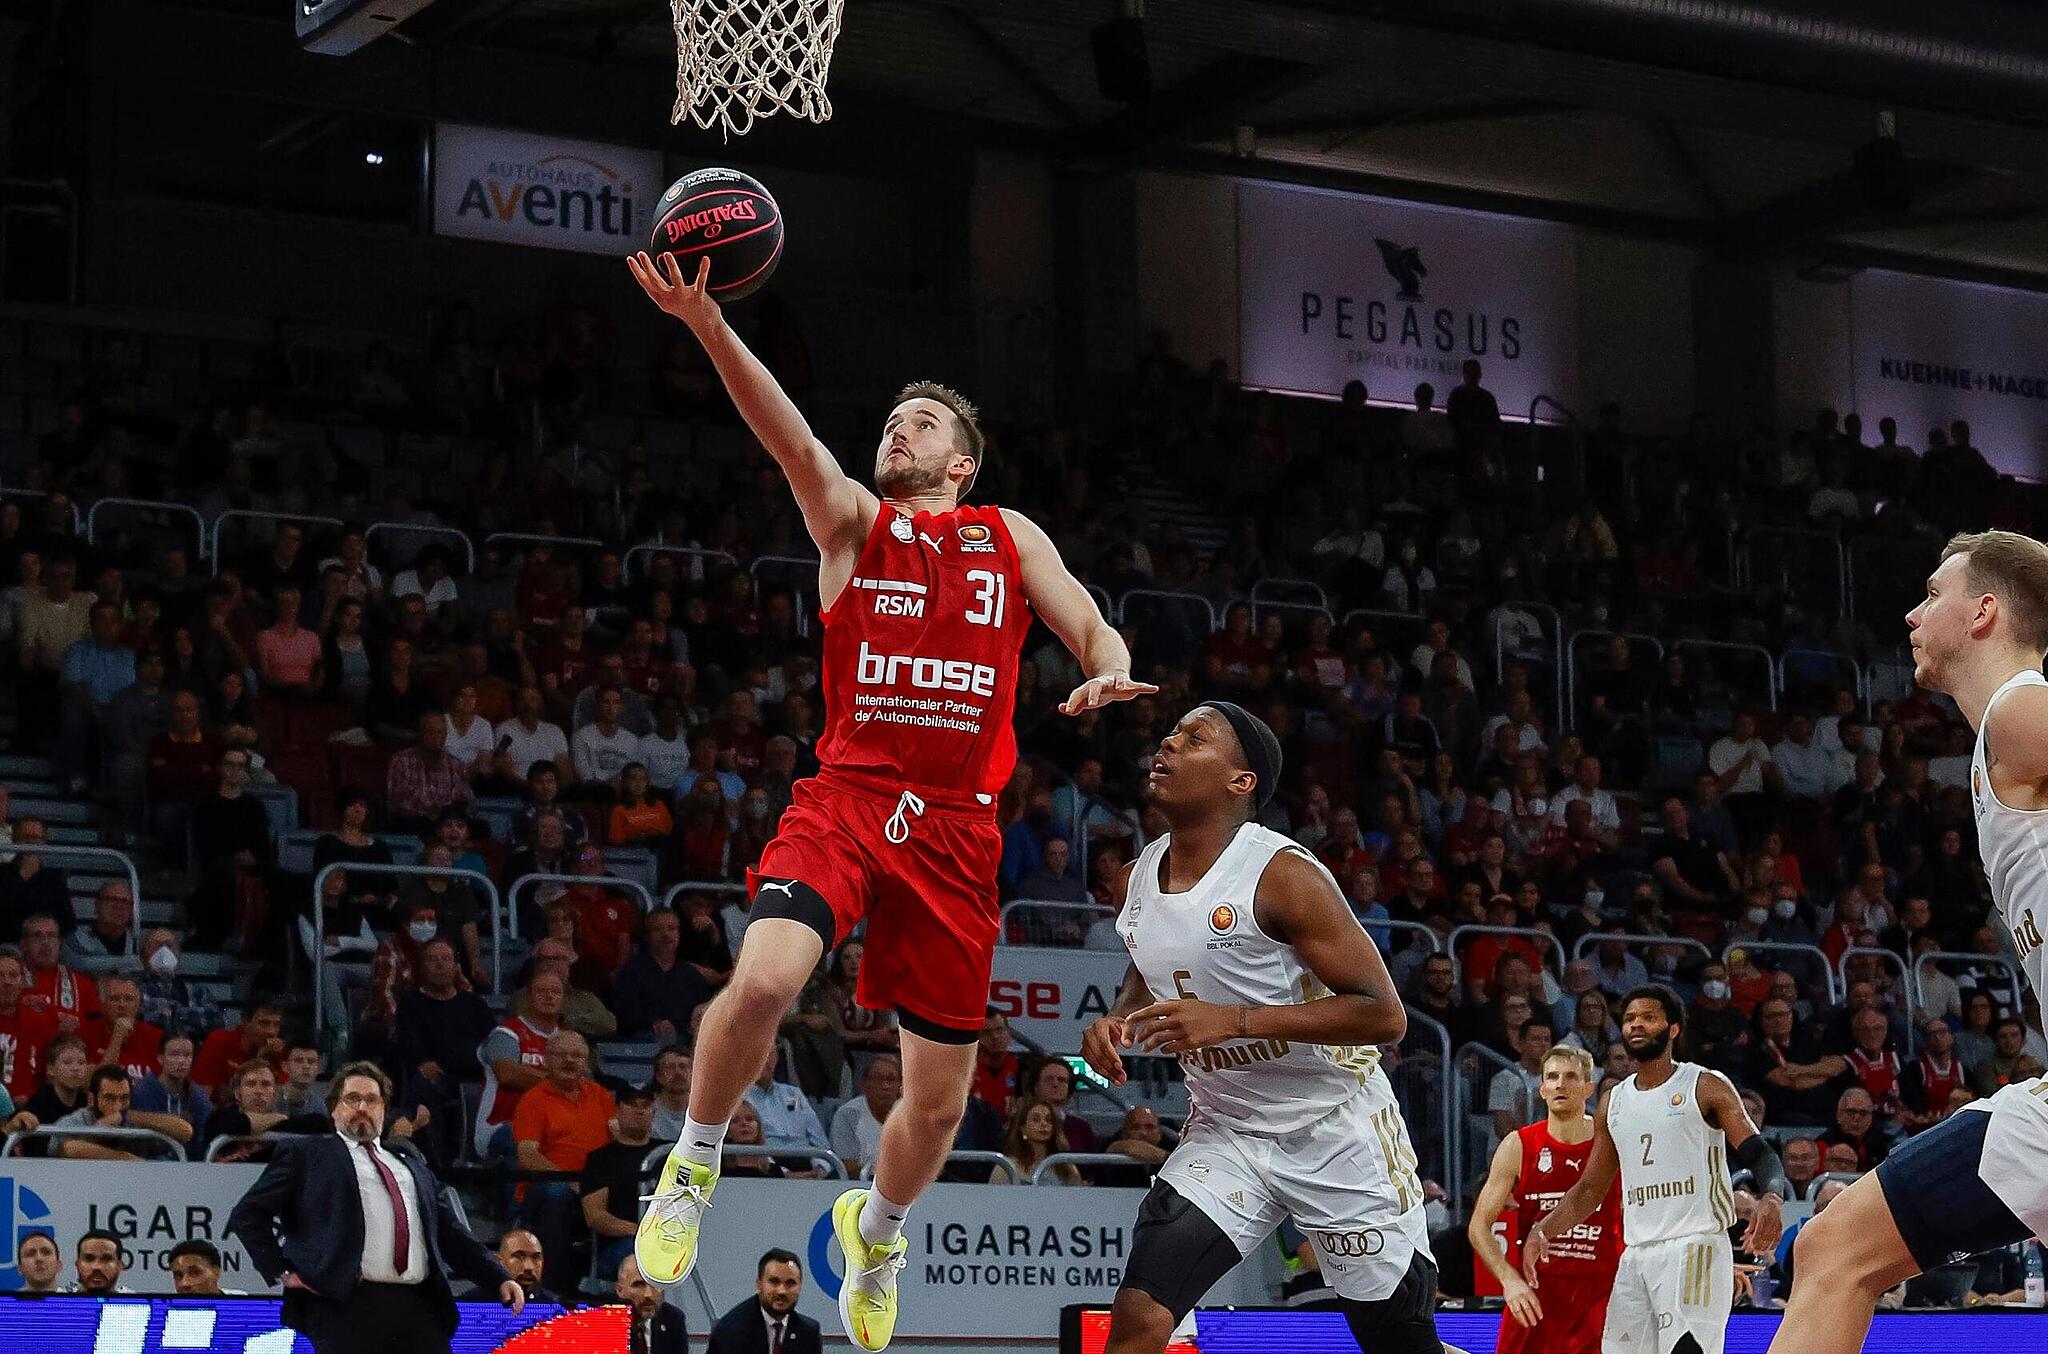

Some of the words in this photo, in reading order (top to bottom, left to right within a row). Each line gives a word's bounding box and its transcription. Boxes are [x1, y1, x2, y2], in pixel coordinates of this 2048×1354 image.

[665, 198, 757, 243] SPALDING
[1301, 290, 1521, 360] PEGASUS
[874, 594, 925, 618] RSM
[964, 569, 1005, 629] 31
[857, 641, 996, 697] brose
[855, 693, 943, 711] Internationaler
[944, 700, 983, 717] Partner
[855, 710, 871, 722] der
[874, 710, 980, 734] Automobilindustrie
[1639, 1133, 1654, 1167] 2
[925, 1222, 1124, 1258] IGARASH
[926, 1264, 1056, 1286] MOTOREN
[1065, 1266, 1121, 1287] GMB
